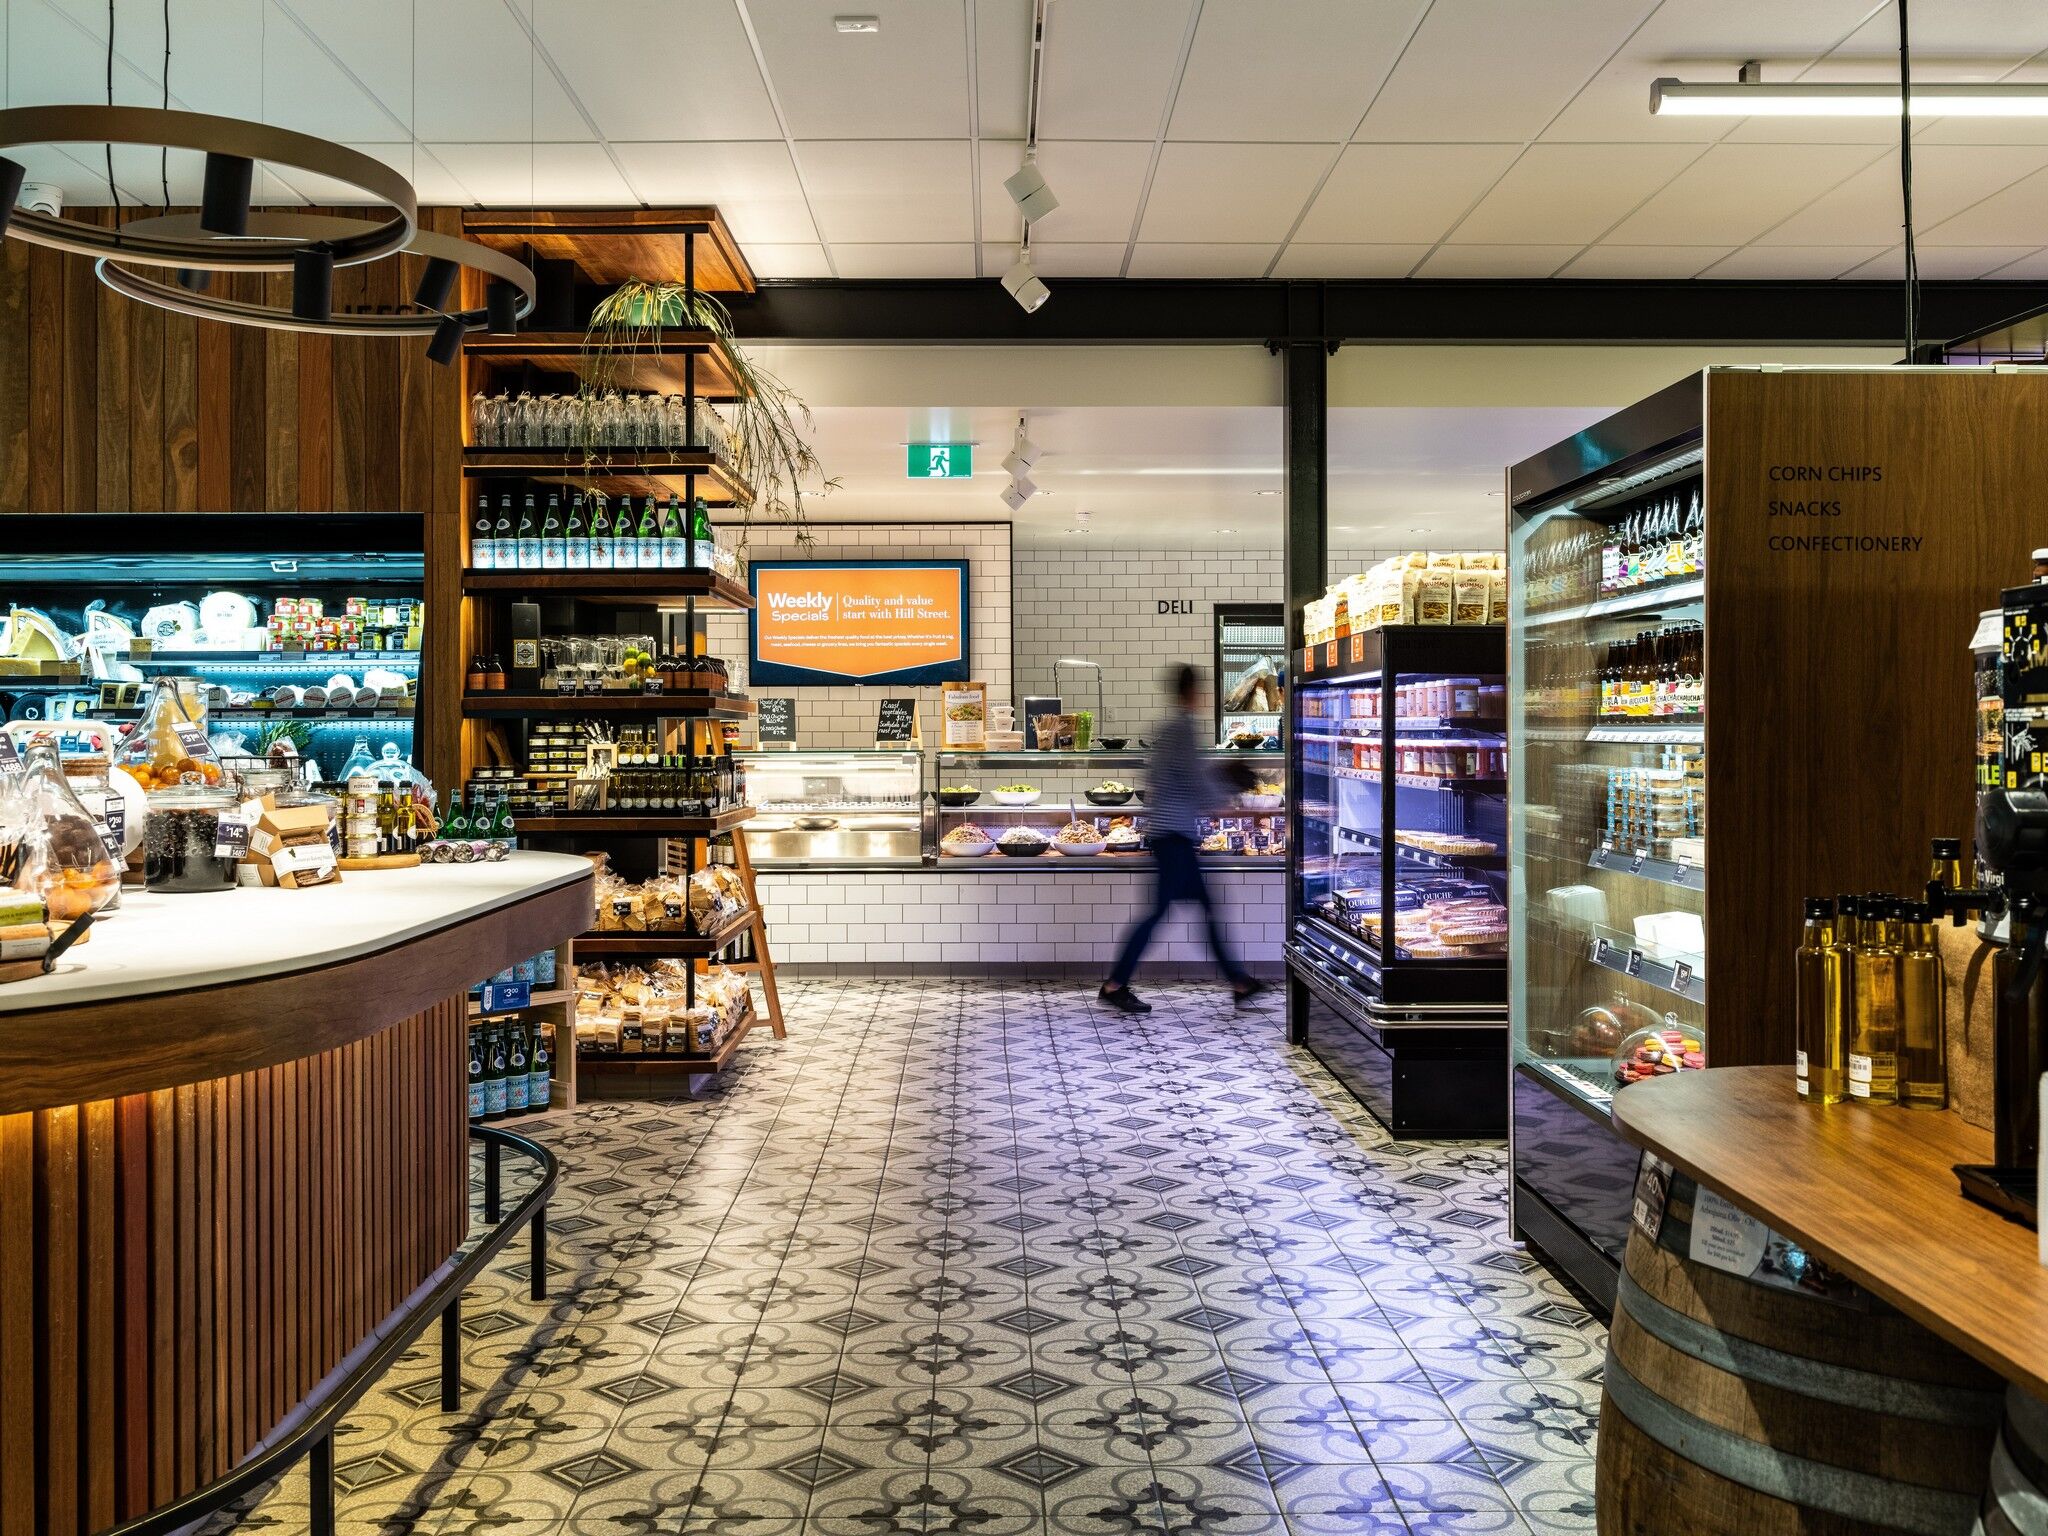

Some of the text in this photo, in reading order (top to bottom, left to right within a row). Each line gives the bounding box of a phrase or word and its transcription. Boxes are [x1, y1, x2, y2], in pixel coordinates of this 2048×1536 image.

[1768, 466, 1882, 482] CORN CHIPS
[1768, 501, 1841, 516] SNACKS
[1768, 536, 1924, 551] CONFECTIONERY
[1424, 580, 1449, 588] RUMMO
[1459, 582, 1485, 590] RUMMO
[768, 592, 832, 612] Weekly
[843, 595, 934, 608] Quality and value
[1158, 600, 1192, 614] DELI
[772, 610, 829, 624] Specials
[843, 608, 950, 620] start with Hill Street.
[882, 700, 900, 708] Roast
[882, 708, 908, 718] vegetables
[1, 762, 22, 772] 1488
[1422, 892, 1453, 900] QUICHE
[1348, 898, 1377, 908] QUICHE
